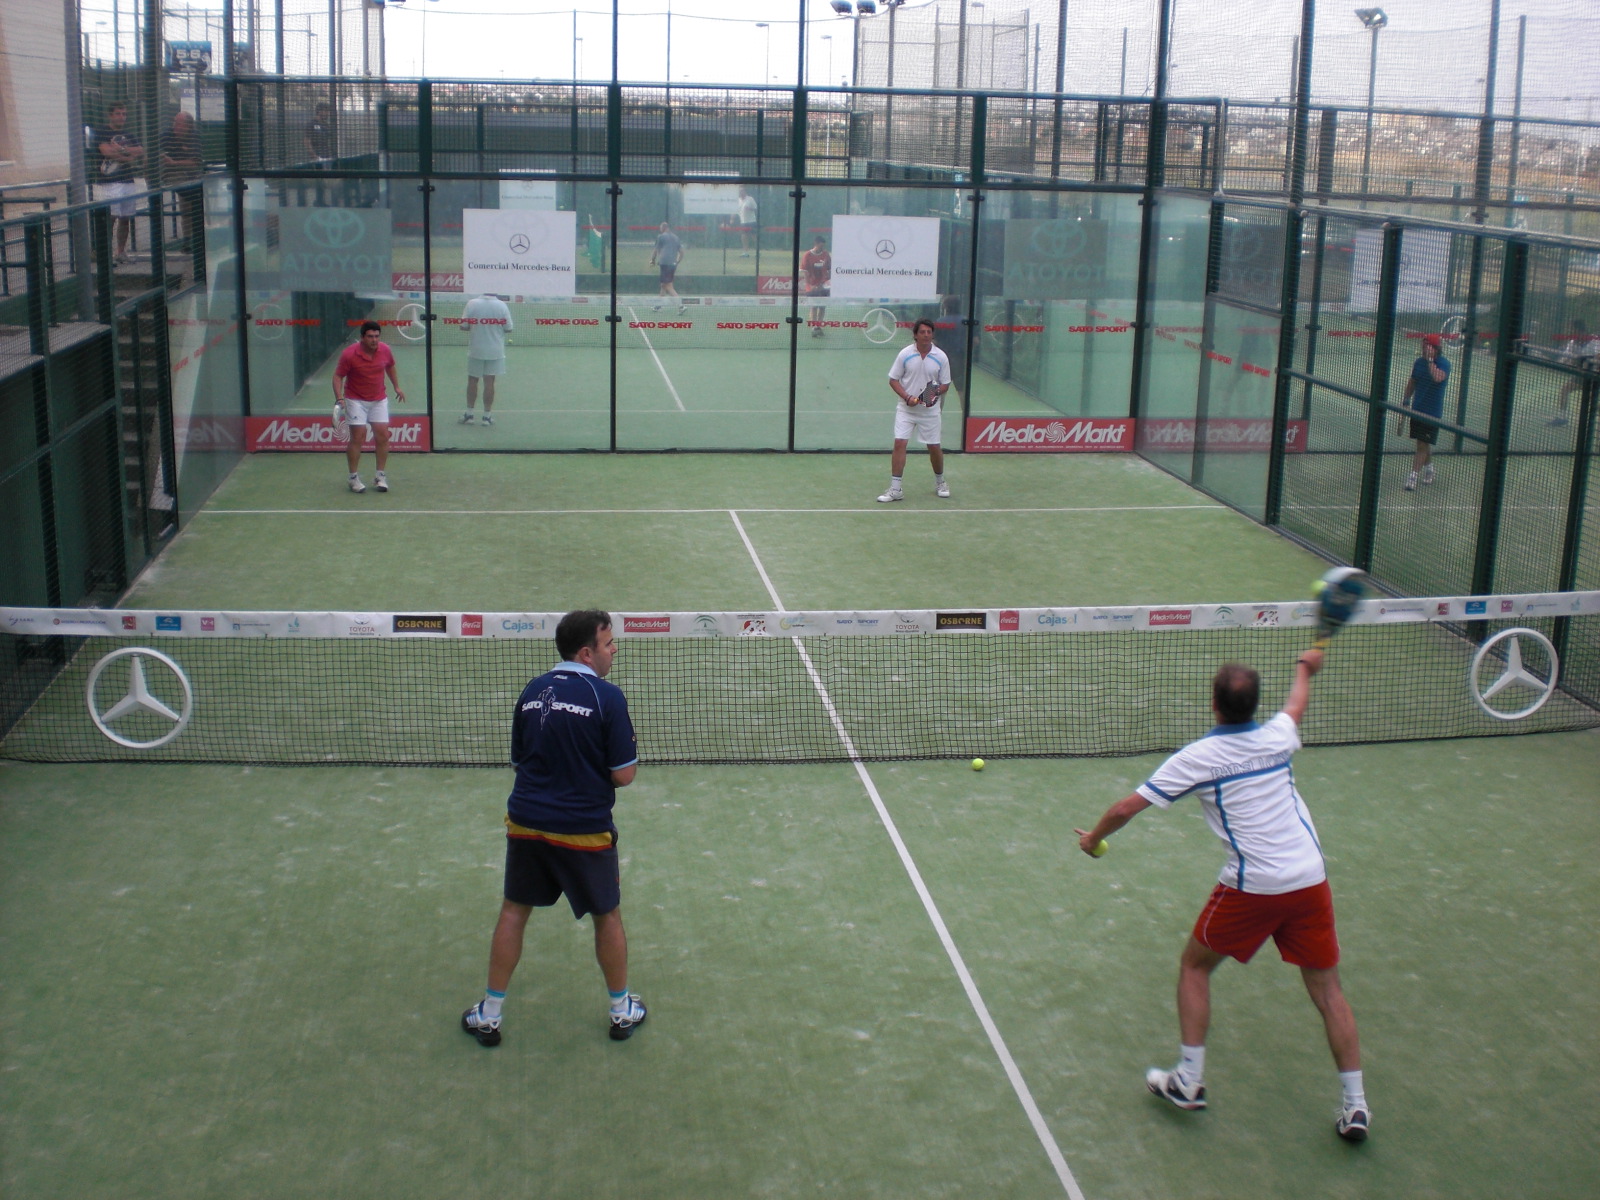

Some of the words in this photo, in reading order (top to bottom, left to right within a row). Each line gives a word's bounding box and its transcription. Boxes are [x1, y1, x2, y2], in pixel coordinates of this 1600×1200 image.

[468, 262, 509, 271] Comercial
[511, 263, 571, 272] Mercedes-Benz
[835, 267, 874, 276] Comercial
[876, 268, 933, 277] Mercedes-Benz
[285, 319, 321, 327] SPORT
[717, 322, 743, 330] SATO
[745, 322, 780, 330] SPORT
[1011, 325, 1045, 333] SPORT
[1068, 325, 1094, 333] SATO
[256, 420, 334, 443] Media
[974, 421, 1047, 443] Media
[1061, 421, 1126, 443] Markt
[397, 620, 442, 629] OSBORNE
[940, 617, 982, 625] OSBORNE
[1037, 613, 1077, 626] Cajasol
[502, 619, 545, 633] Cajasol
[521, 700, 542, 712] SATO
[551, 702, 594, 718] SPORT
